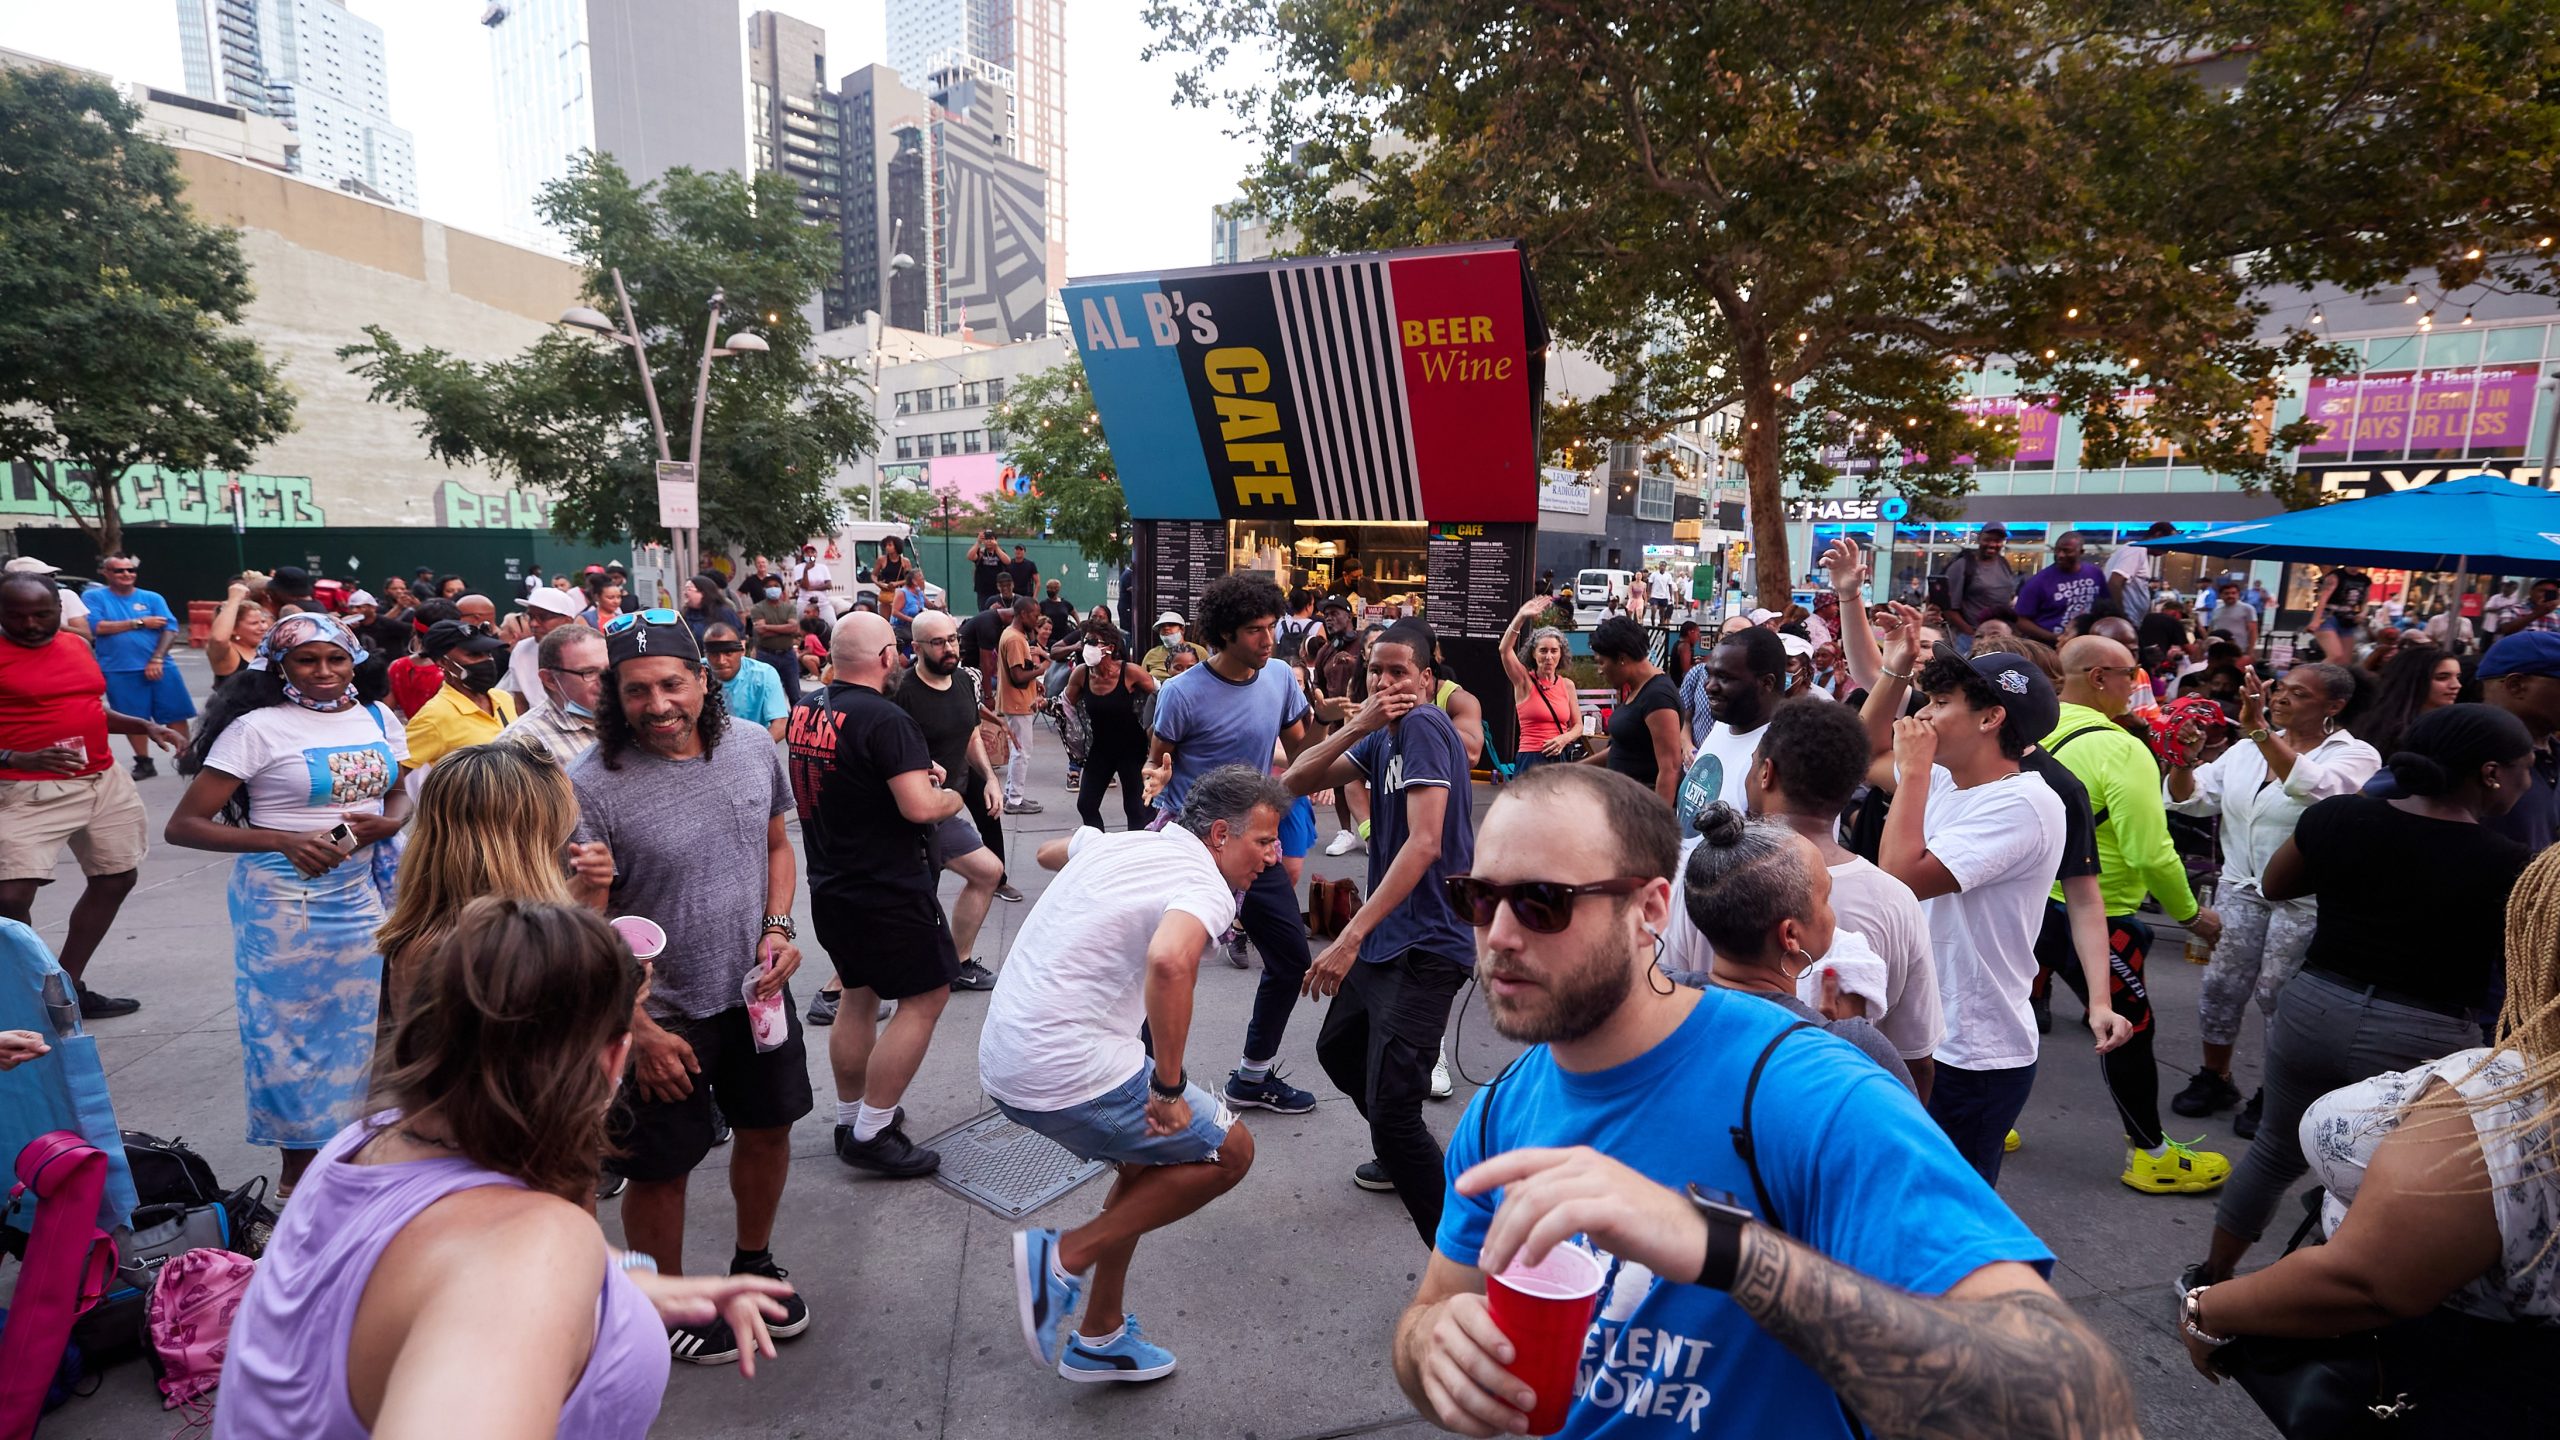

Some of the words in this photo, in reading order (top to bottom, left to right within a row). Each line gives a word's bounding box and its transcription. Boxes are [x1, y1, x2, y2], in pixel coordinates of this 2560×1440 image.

[1081, 297, 1140, 351] AL
[1142, 290, 1219, 347] B's
[1403, 315, 1495, 348] BEER
[1418, 350, 1512, 383] Wine
[2488, 388, 2511, 407] IN
[1204, 346, 1298, 506] CAFE
[2342, 415, 2402, 441] DAYS
[2445, 411, 2510, 437] LESS
[1789, 500, 1879, 520] CHASE
[1457, 524, 1484, 536] CAFE
